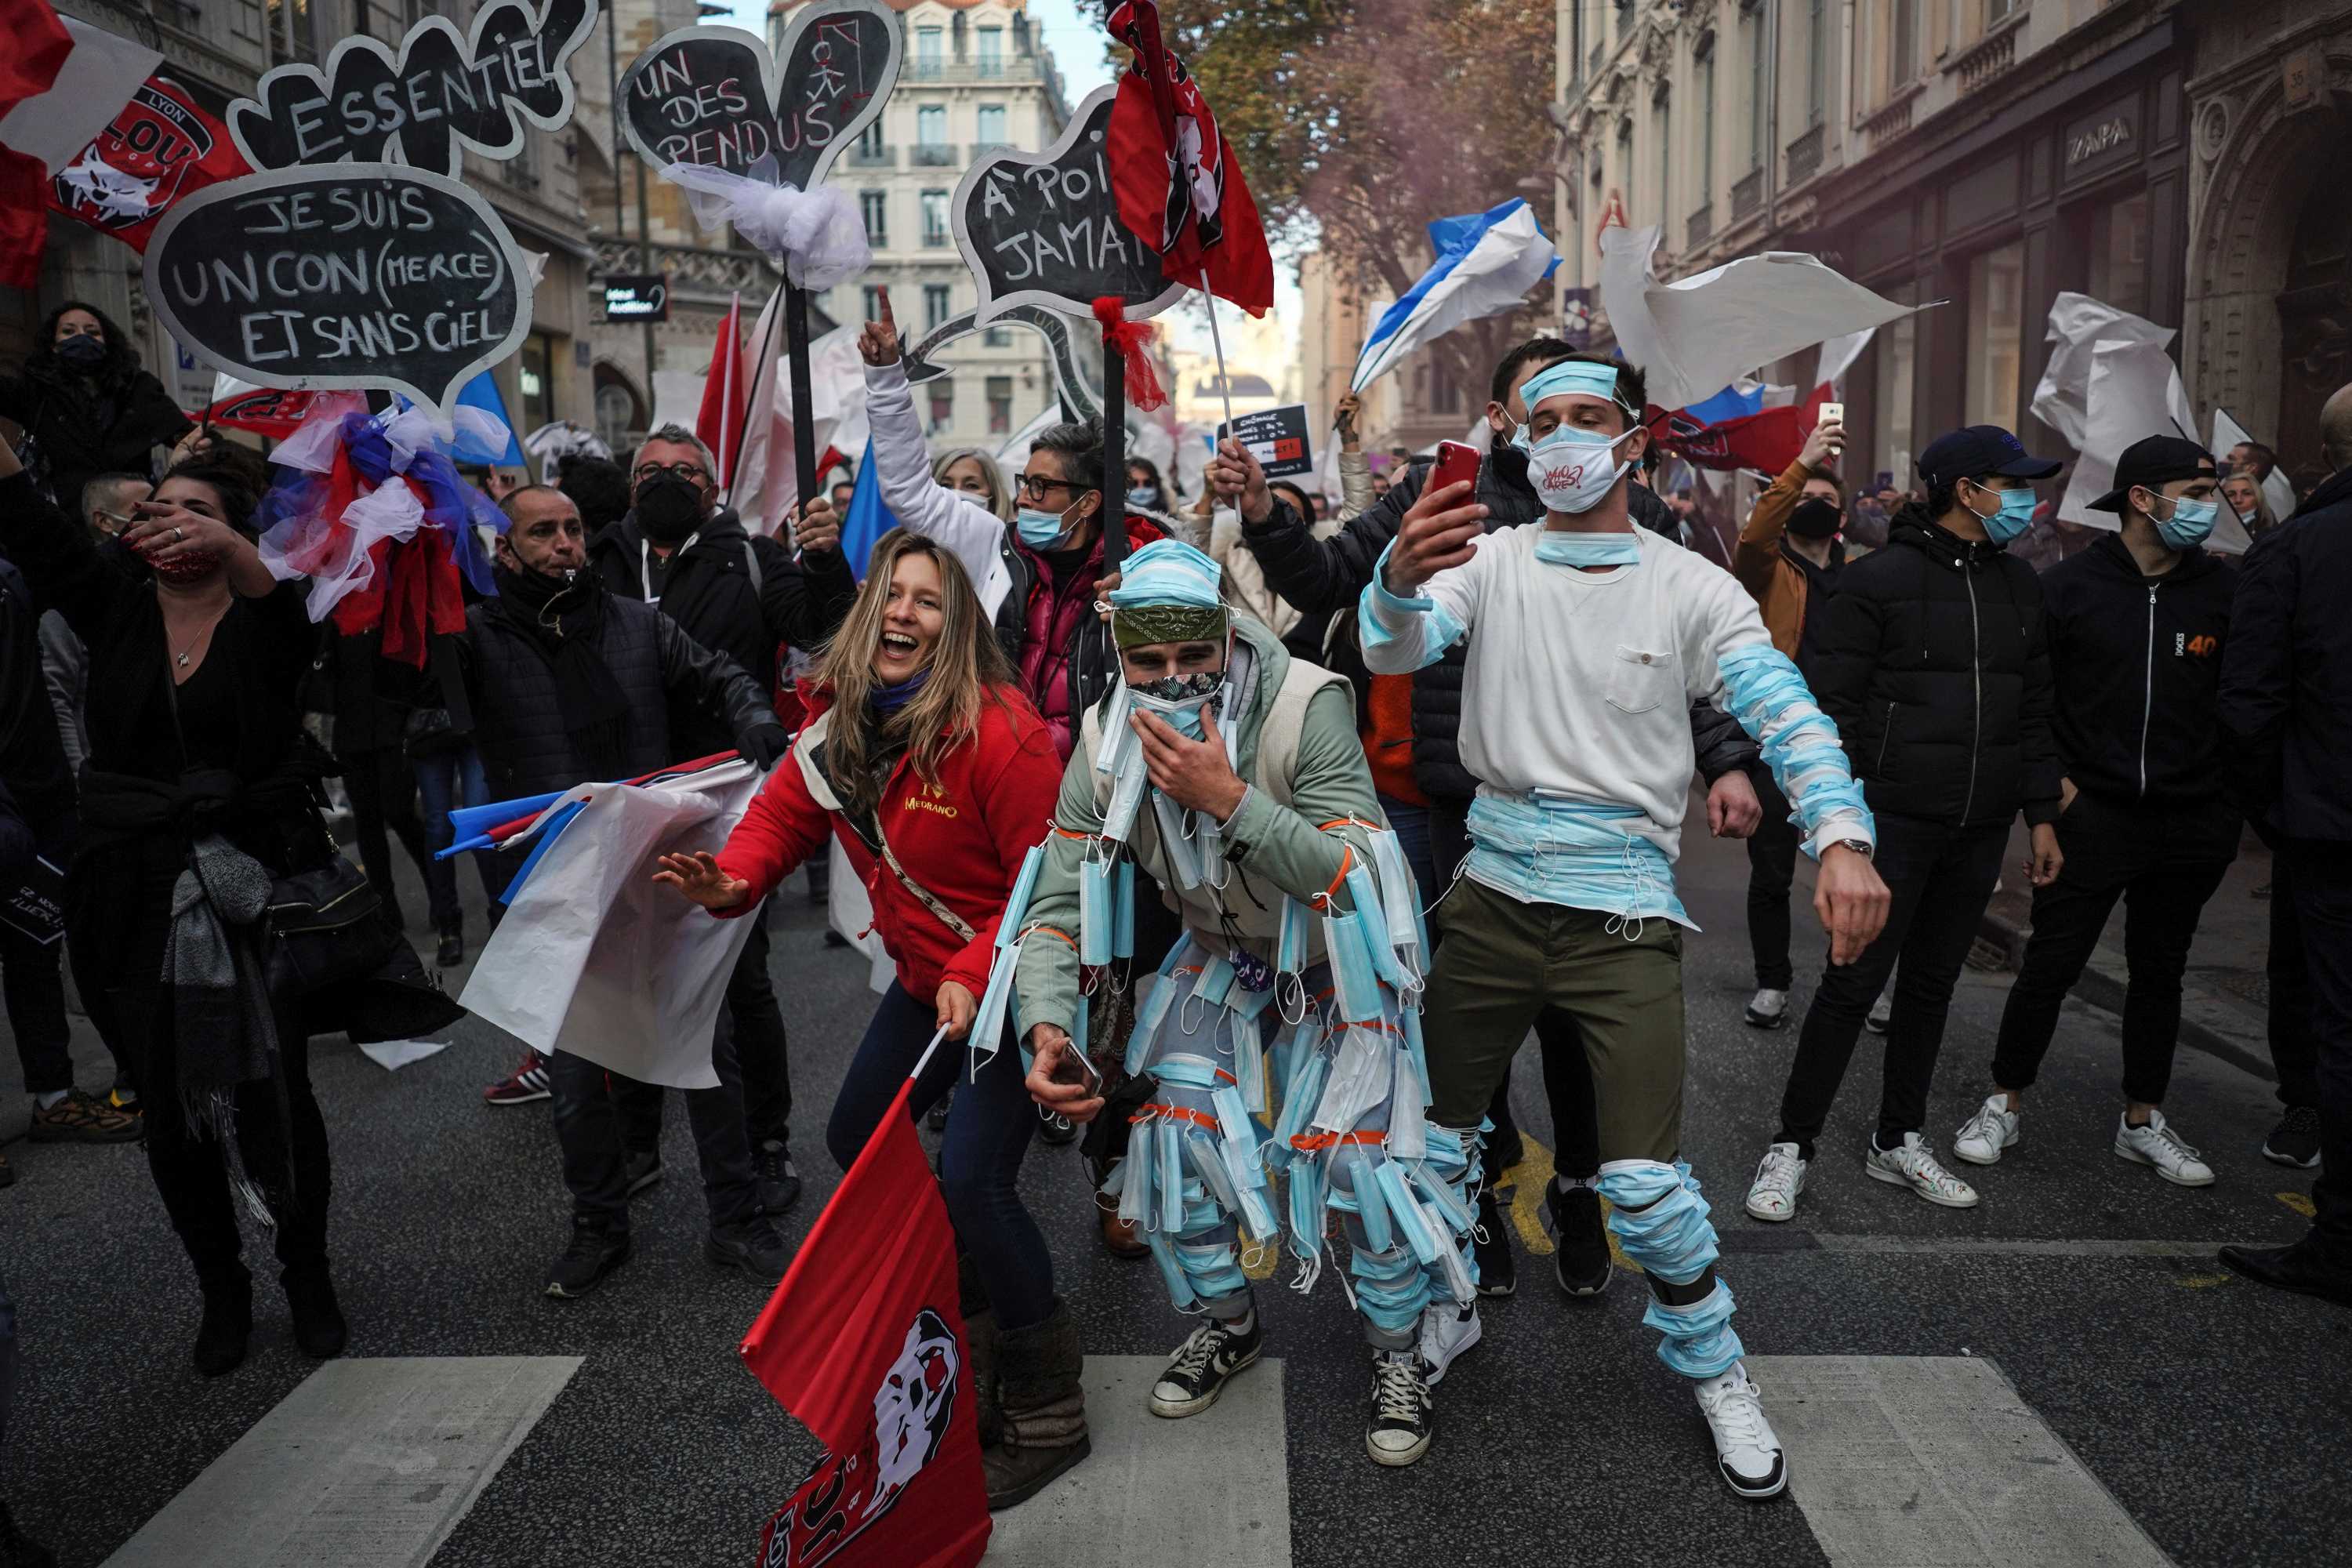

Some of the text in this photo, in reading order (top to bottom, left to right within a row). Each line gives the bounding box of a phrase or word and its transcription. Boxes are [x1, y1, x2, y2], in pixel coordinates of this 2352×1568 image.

[636, 49, 692, 100] UN
[149, 93, 187, 123] LYON
[660, 78, 748, 129] DES
[96, 132, 171, 176] UGBY
[102, 118, 194, 165] LOU
[656, 101, 835, 167] PENDUS
[235, 191, 324, 234] JE
[993, 215, 1145, 281] JAMAI
[172, 251, 260, 307] UN
[241, 309, 305, 363] ET
[313, 310, 421, 359] SANS
[1543, 464, 1570, 481] WHO
[2187, 635, 2216, 655] 40
